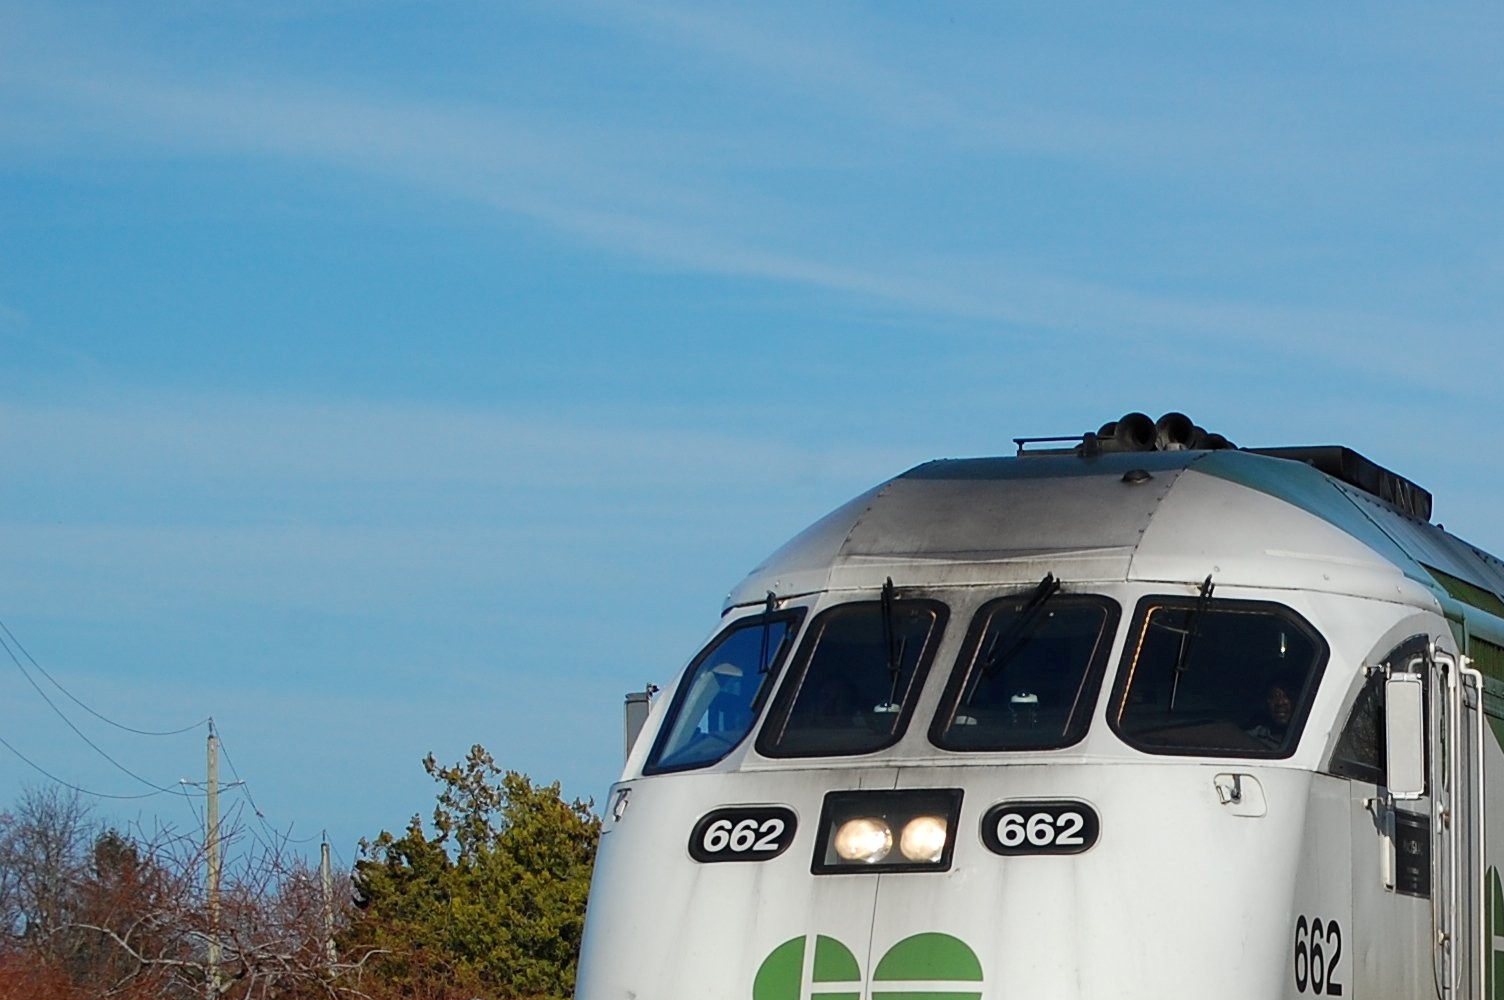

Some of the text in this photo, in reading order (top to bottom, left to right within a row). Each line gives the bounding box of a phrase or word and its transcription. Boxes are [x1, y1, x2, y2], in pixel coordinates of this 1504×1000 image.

[703, 818, 785, 853] 662
[998, 811, 1084, 847] 662
[1294, 914, 1343, 997] 662
